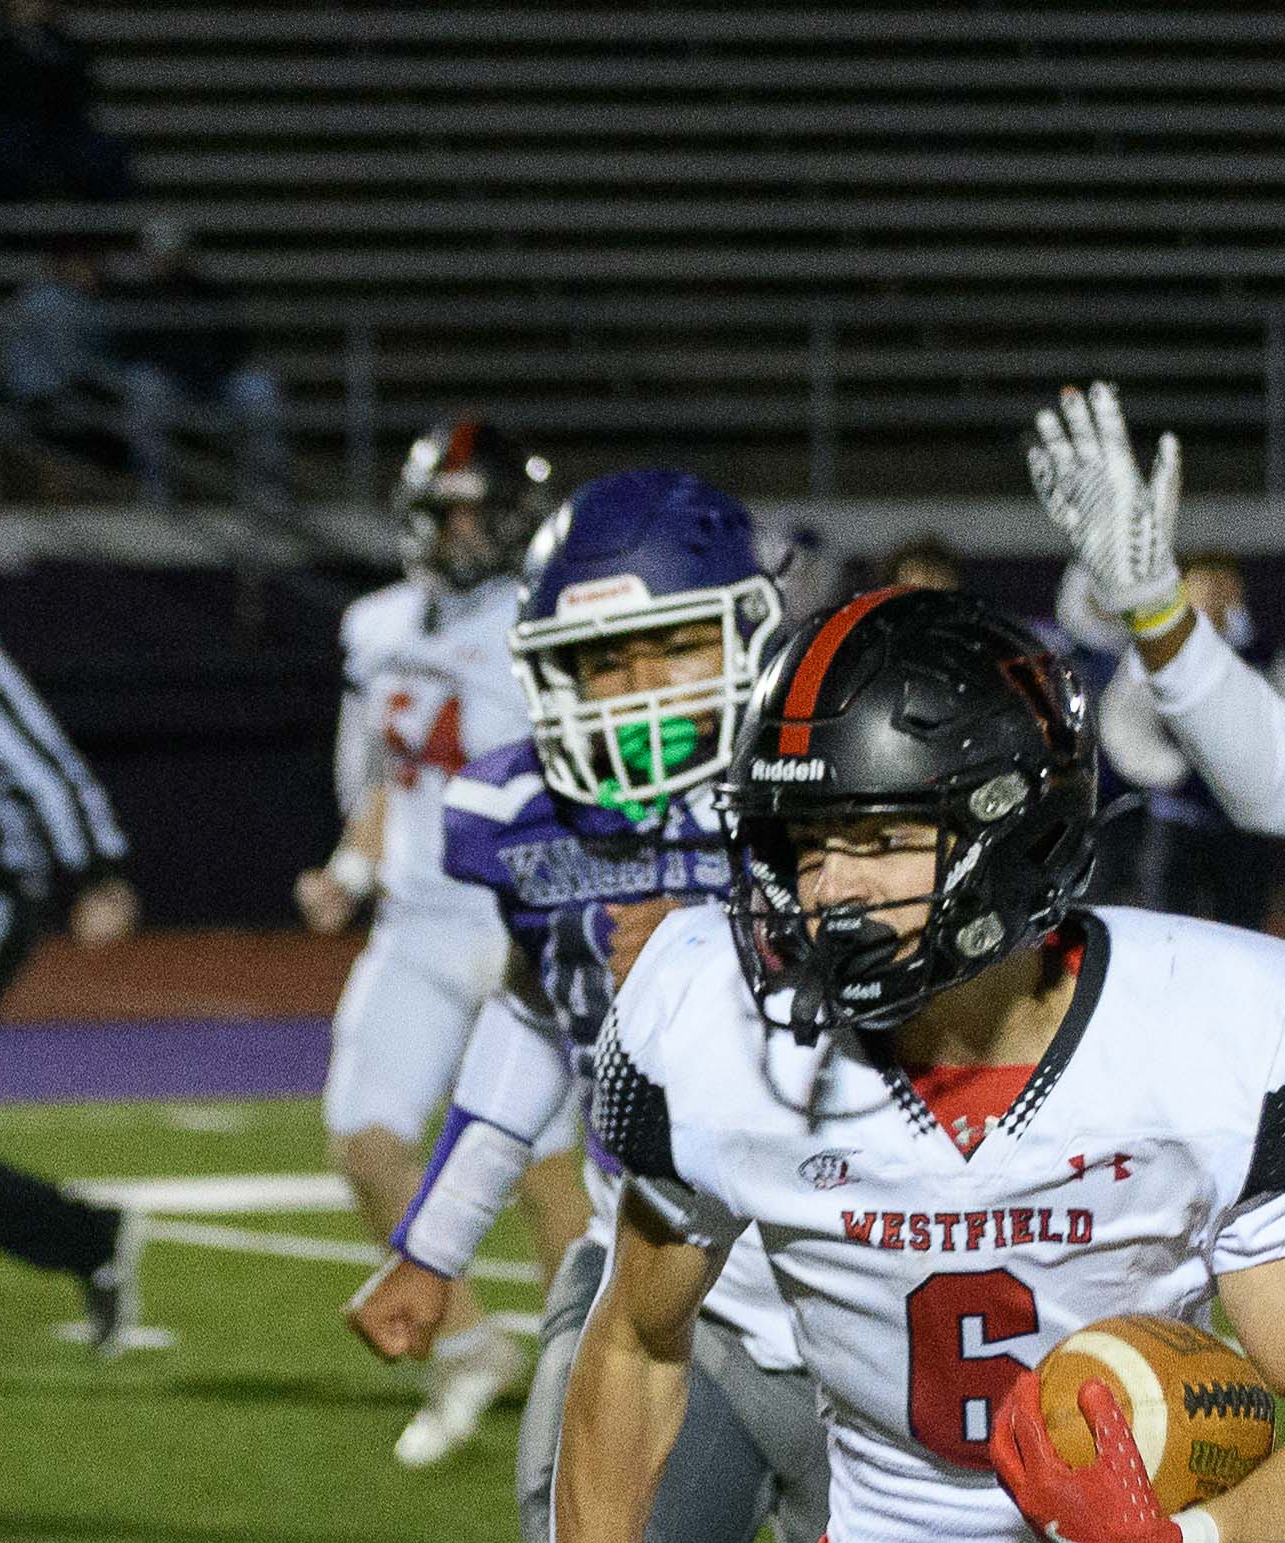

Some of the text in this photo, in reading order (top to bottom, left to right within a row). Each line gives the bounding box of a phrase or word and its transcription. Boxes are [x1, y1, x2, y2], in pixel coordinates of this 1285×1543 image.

[751, 758, 826, 782] Riddell
[841, 980, 882, 1001] ddell
[840, 1207, 1093, 1251] WESTFIELD
[905, 1266, 1040, 1471] 6
